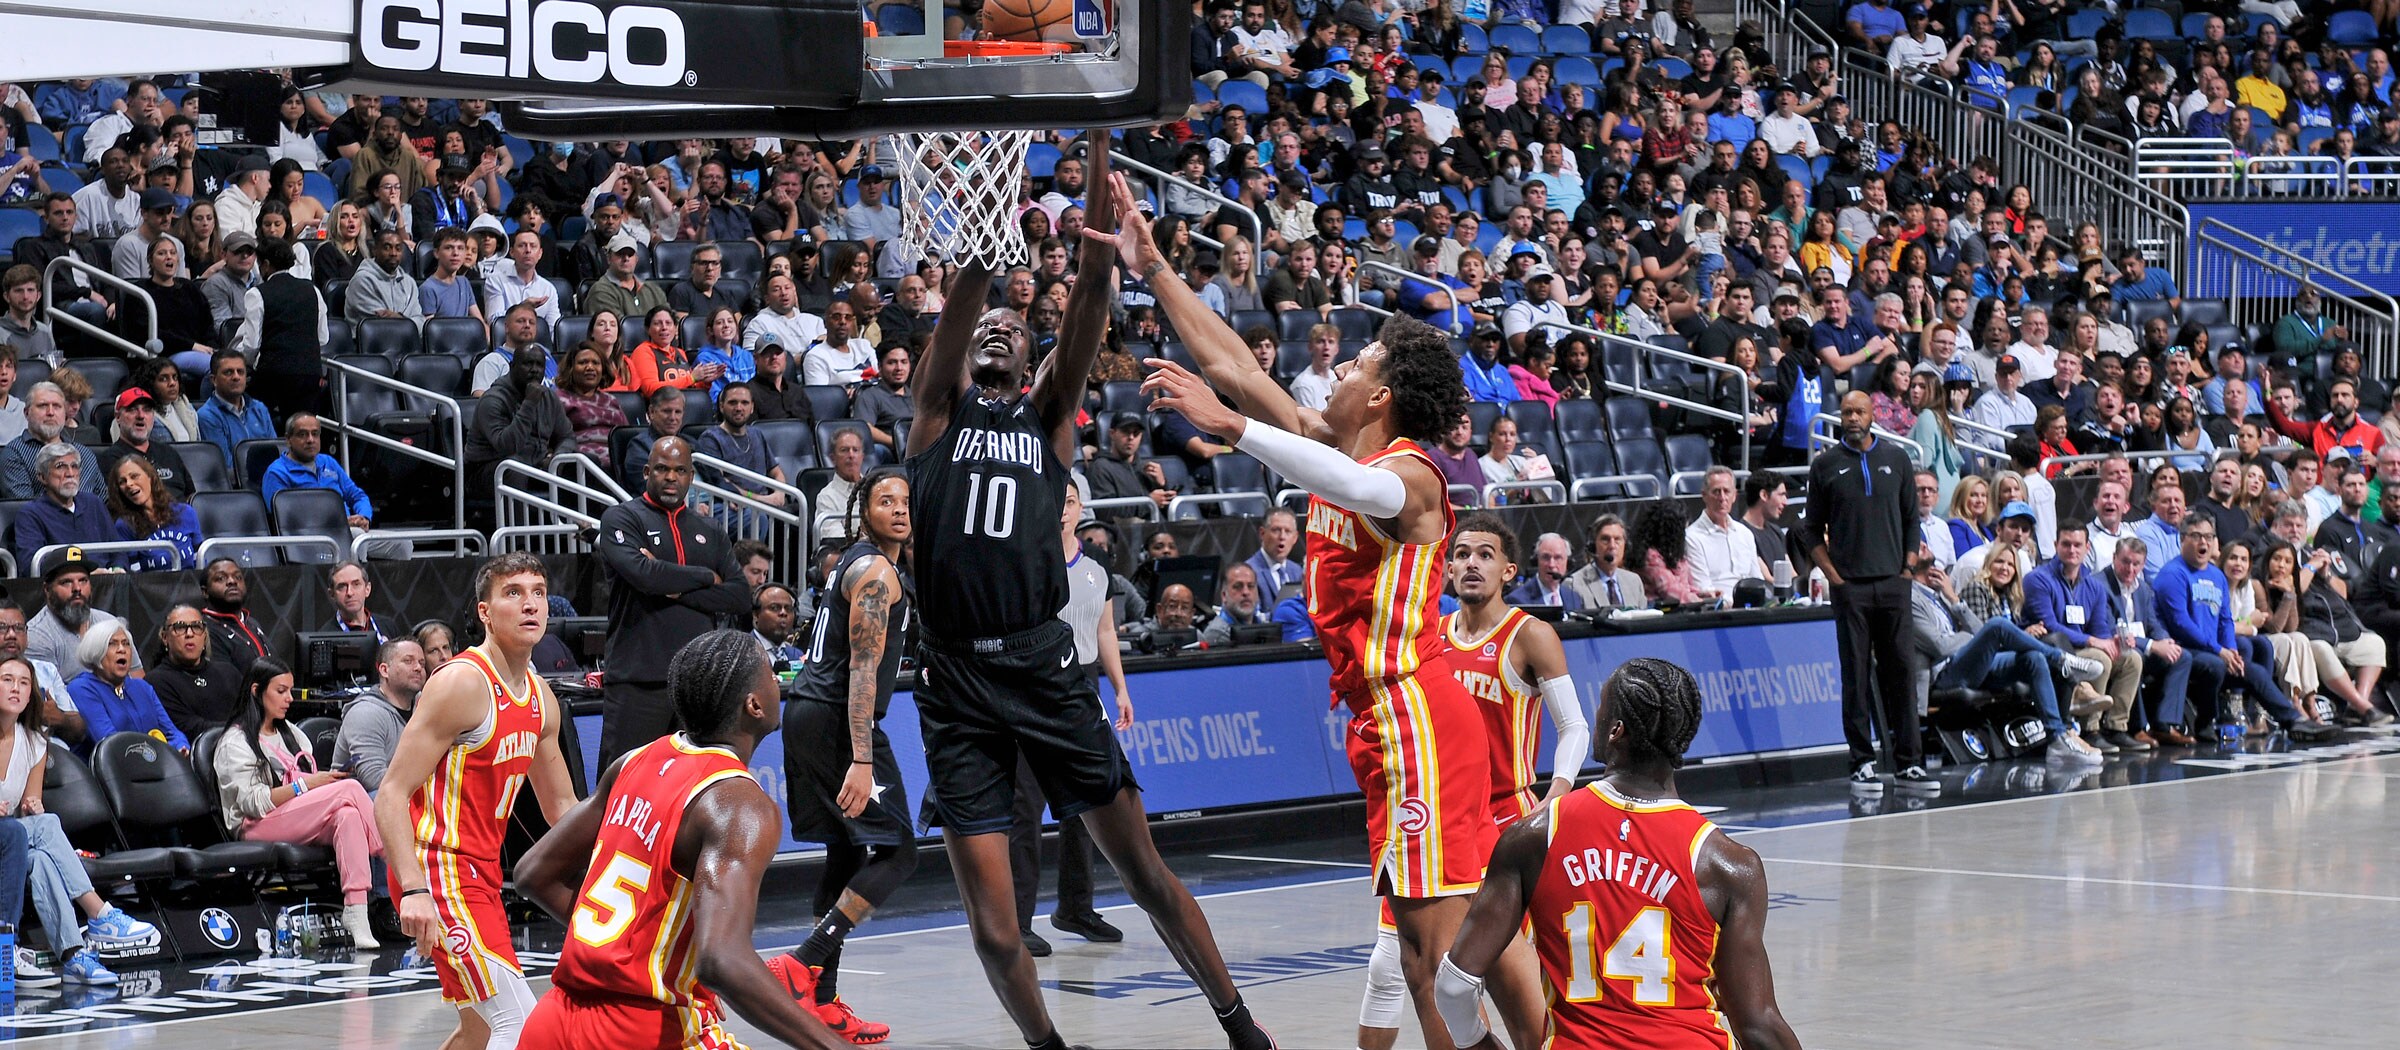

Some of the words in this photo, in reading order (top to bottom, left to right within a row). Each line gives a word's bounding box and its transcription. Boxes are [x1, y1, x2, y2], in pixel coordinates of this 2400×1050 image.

[1079, 11, 1098, 31] NBA
[360, 0, 686, 87] GEICO
[1120, 291, 1156, 307] RLANDO
[1803, 377, 1822, 404] 22
[952, 427, 1042, 475] ORANDO
[963, 472, 1017, 539] 10
[148, 530, 188, 544] LANDO
[1306, 503, 1357, 552] ANTA
[67, 546, 82, 561] C
[1307, 556, 1319, 615] 1
[973, 638, 1003, 653] MAGIC
[494, 684, 503, 697] 6
[1453, 670, 1504, 705] ANTA
[1699, 666, 1786, 712] HAPPENS
[1786, 661, 1840, 705] ONCE
[492, 731, 539, 766] ATLANT
[1118, 715, 1198, 766] PPENS
[1200, 711, 1275, 760] ONCE.
[606, 794, 662, 852] APELA
[1162, 810, 1202, 821] DAKTRONICS
[572, 840, 653, 948] 5
[1562, 847, 1679, 904] GRIFFIN
[119, 948, 137, 958] AUTO
[138, 946, 161, 957] GROUP
[1561, 901, 1675, 1006] 14
